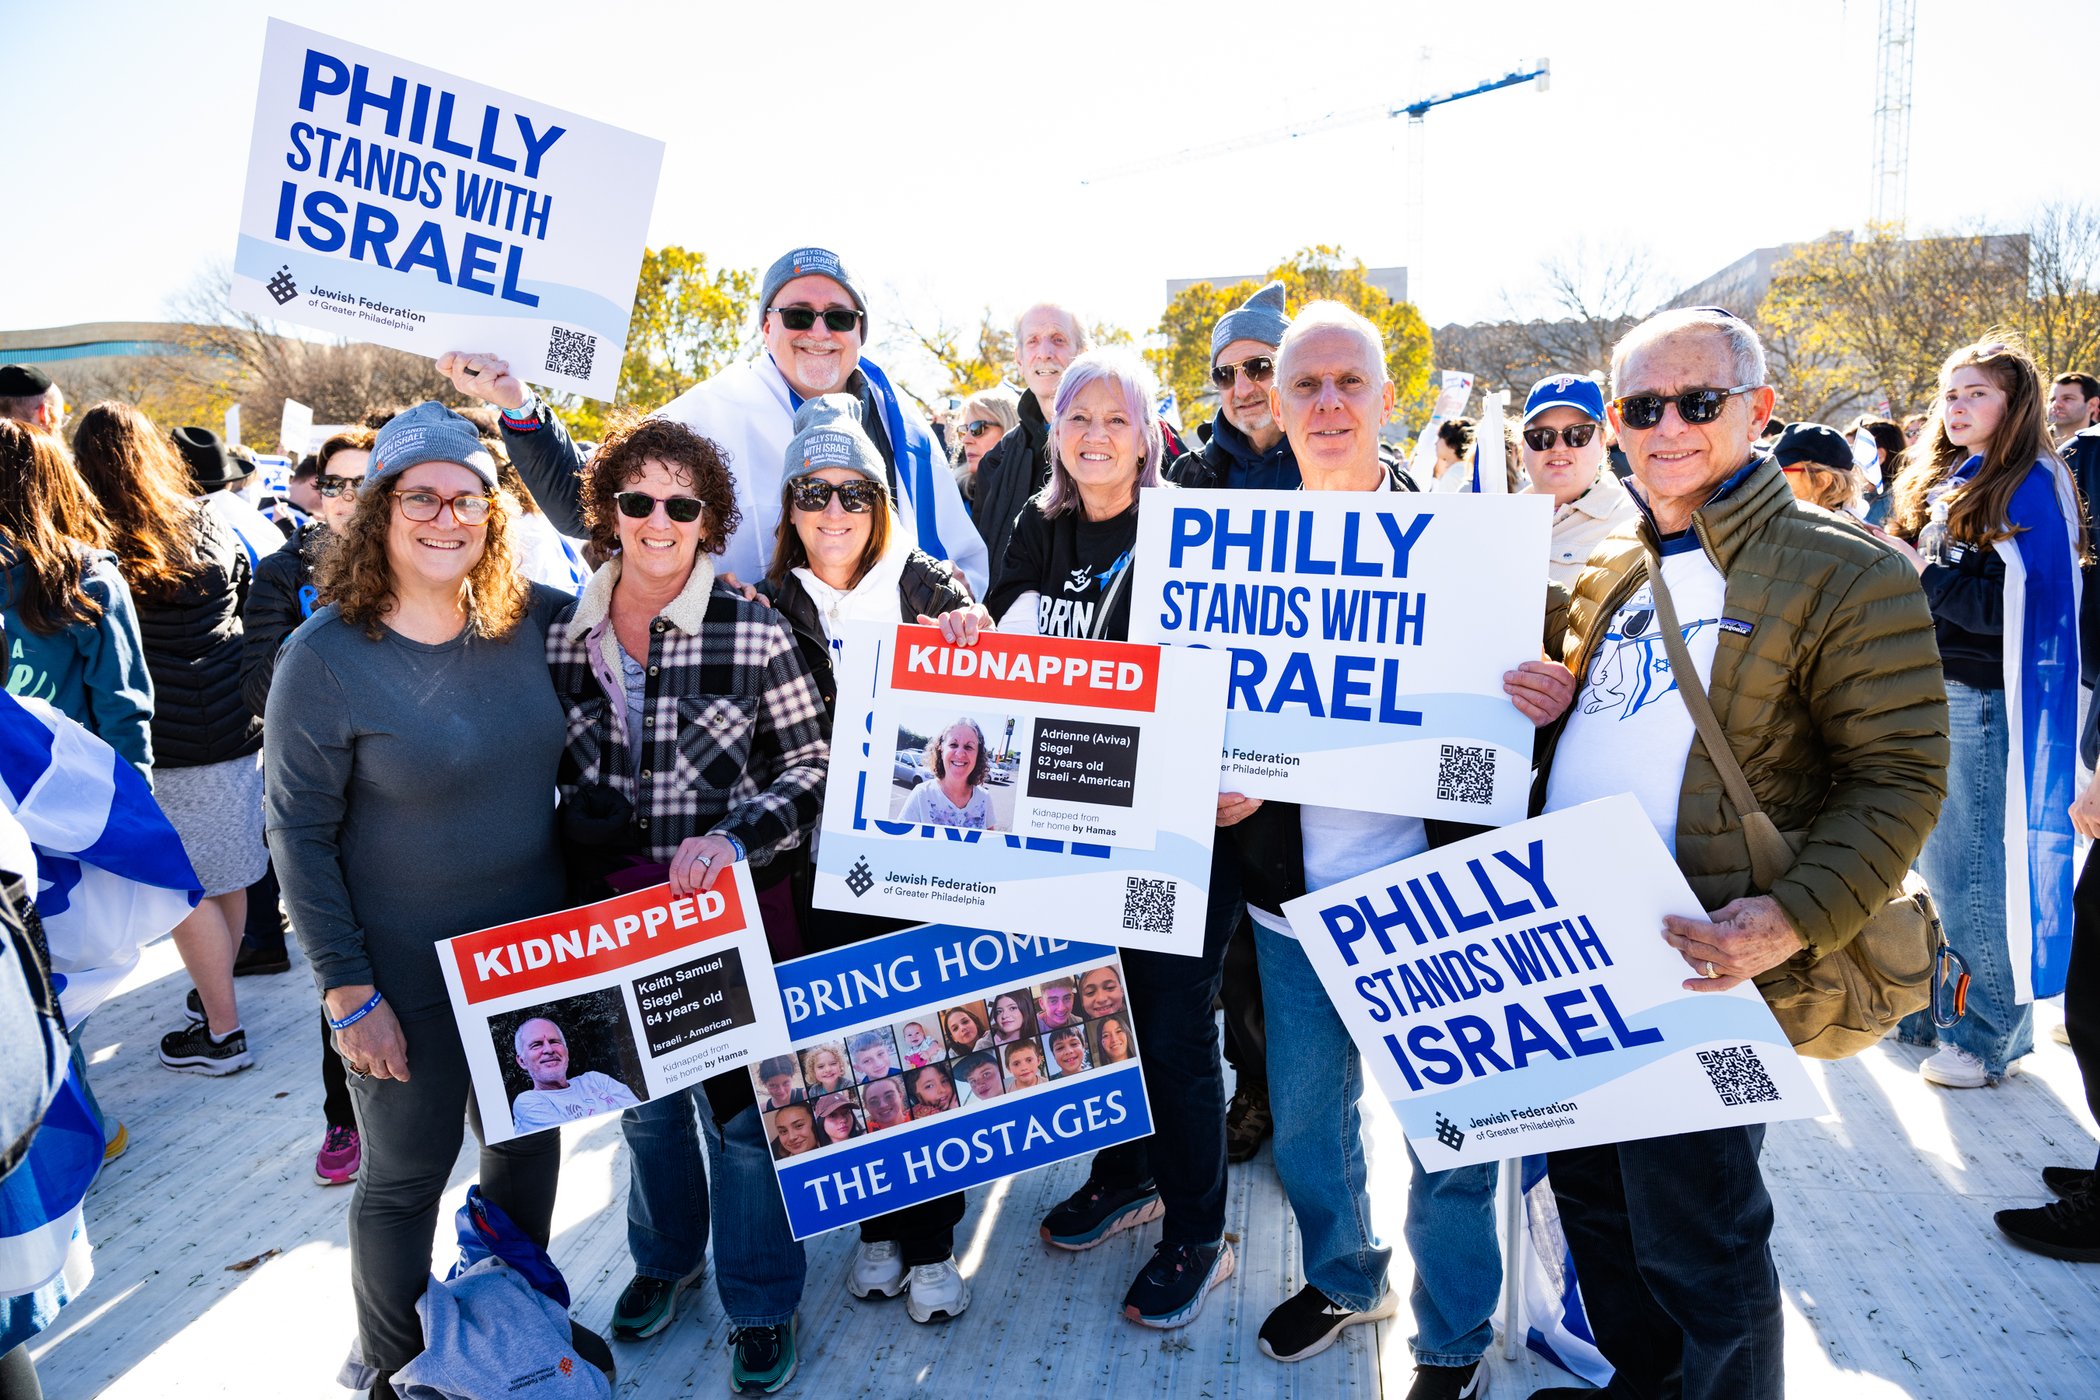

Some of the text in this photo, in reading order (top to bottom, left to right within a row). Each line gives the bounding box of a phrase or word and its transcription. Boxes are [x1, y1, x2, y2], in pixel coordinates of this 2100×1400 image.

[298, 48, 566, 179] PHILLY
[286, 122, 552, 240] STANDS WITH
[274, 180, 540, 308] ISRAEL
[308, 299, 414, 332] of Greater Philadelphia
[310, 285, 426, 323] Jewish Federation
[394, 432, 426, 448] ISRAEL
[803, 443, 851, 457] WITH ISRAEL
[804, 433, 851, 447] PHILLY STANDS
[1168, 507, 1435, 578] PHILLY
[1160, 580, 1427, 646] STANDS WITH
[907, 644, 1144, 692] KIDNAPPED
[1158, 642, 1422, 726] RAEL
[1039, 741, 1073, 756] Siegel
[1040, 728, 1131, 748] Adrienne (Aviva)
[1038, 755, 1104, 771] 62 years old
[1232, 748, 1300, 766] Federation
[1232, 763, 1289, 778] Philadelphia
[1036, 769, 1069, 782] Israeli
[1078, 774, 1131, 788] American
[1031, 820, 1117, 836] her home by Hamas
[1032, 807, 1100, 822] Kidnapped from
[883, 886, 985, 906] of Greater Philadelphia
[885, 871, 996, 895] Jewish Federation
[1319, 839, 1559, 967] PHILLY
[473, 889, 726, 982] KIDNAPPED
[638, 957, 723, 996] Keith Samuel
[1354, 914, 1614, 1023] STANDS WITH
[642, 988, 683, 1011] Siegel
[783, 955, 922, 1024] BRING
[646, 990, 723, 1026] 64 years old
[653, 1034, 683, 1052] Israeli
[689, 1017, 733, 1039] American
[1382, 983, 1665, 1092] ISRAEL
[662, 1042, 730, 1073] Kidnapped from
[665, 1048, 749, 1084] his home by Hamas
[1469, 1101, 1578, 1129] Jewish Federation
[1475, 1116, 1576, 1140] of Greater Philadelphia
[803, 1089, 1128, 1212] THE HOSTAGES
